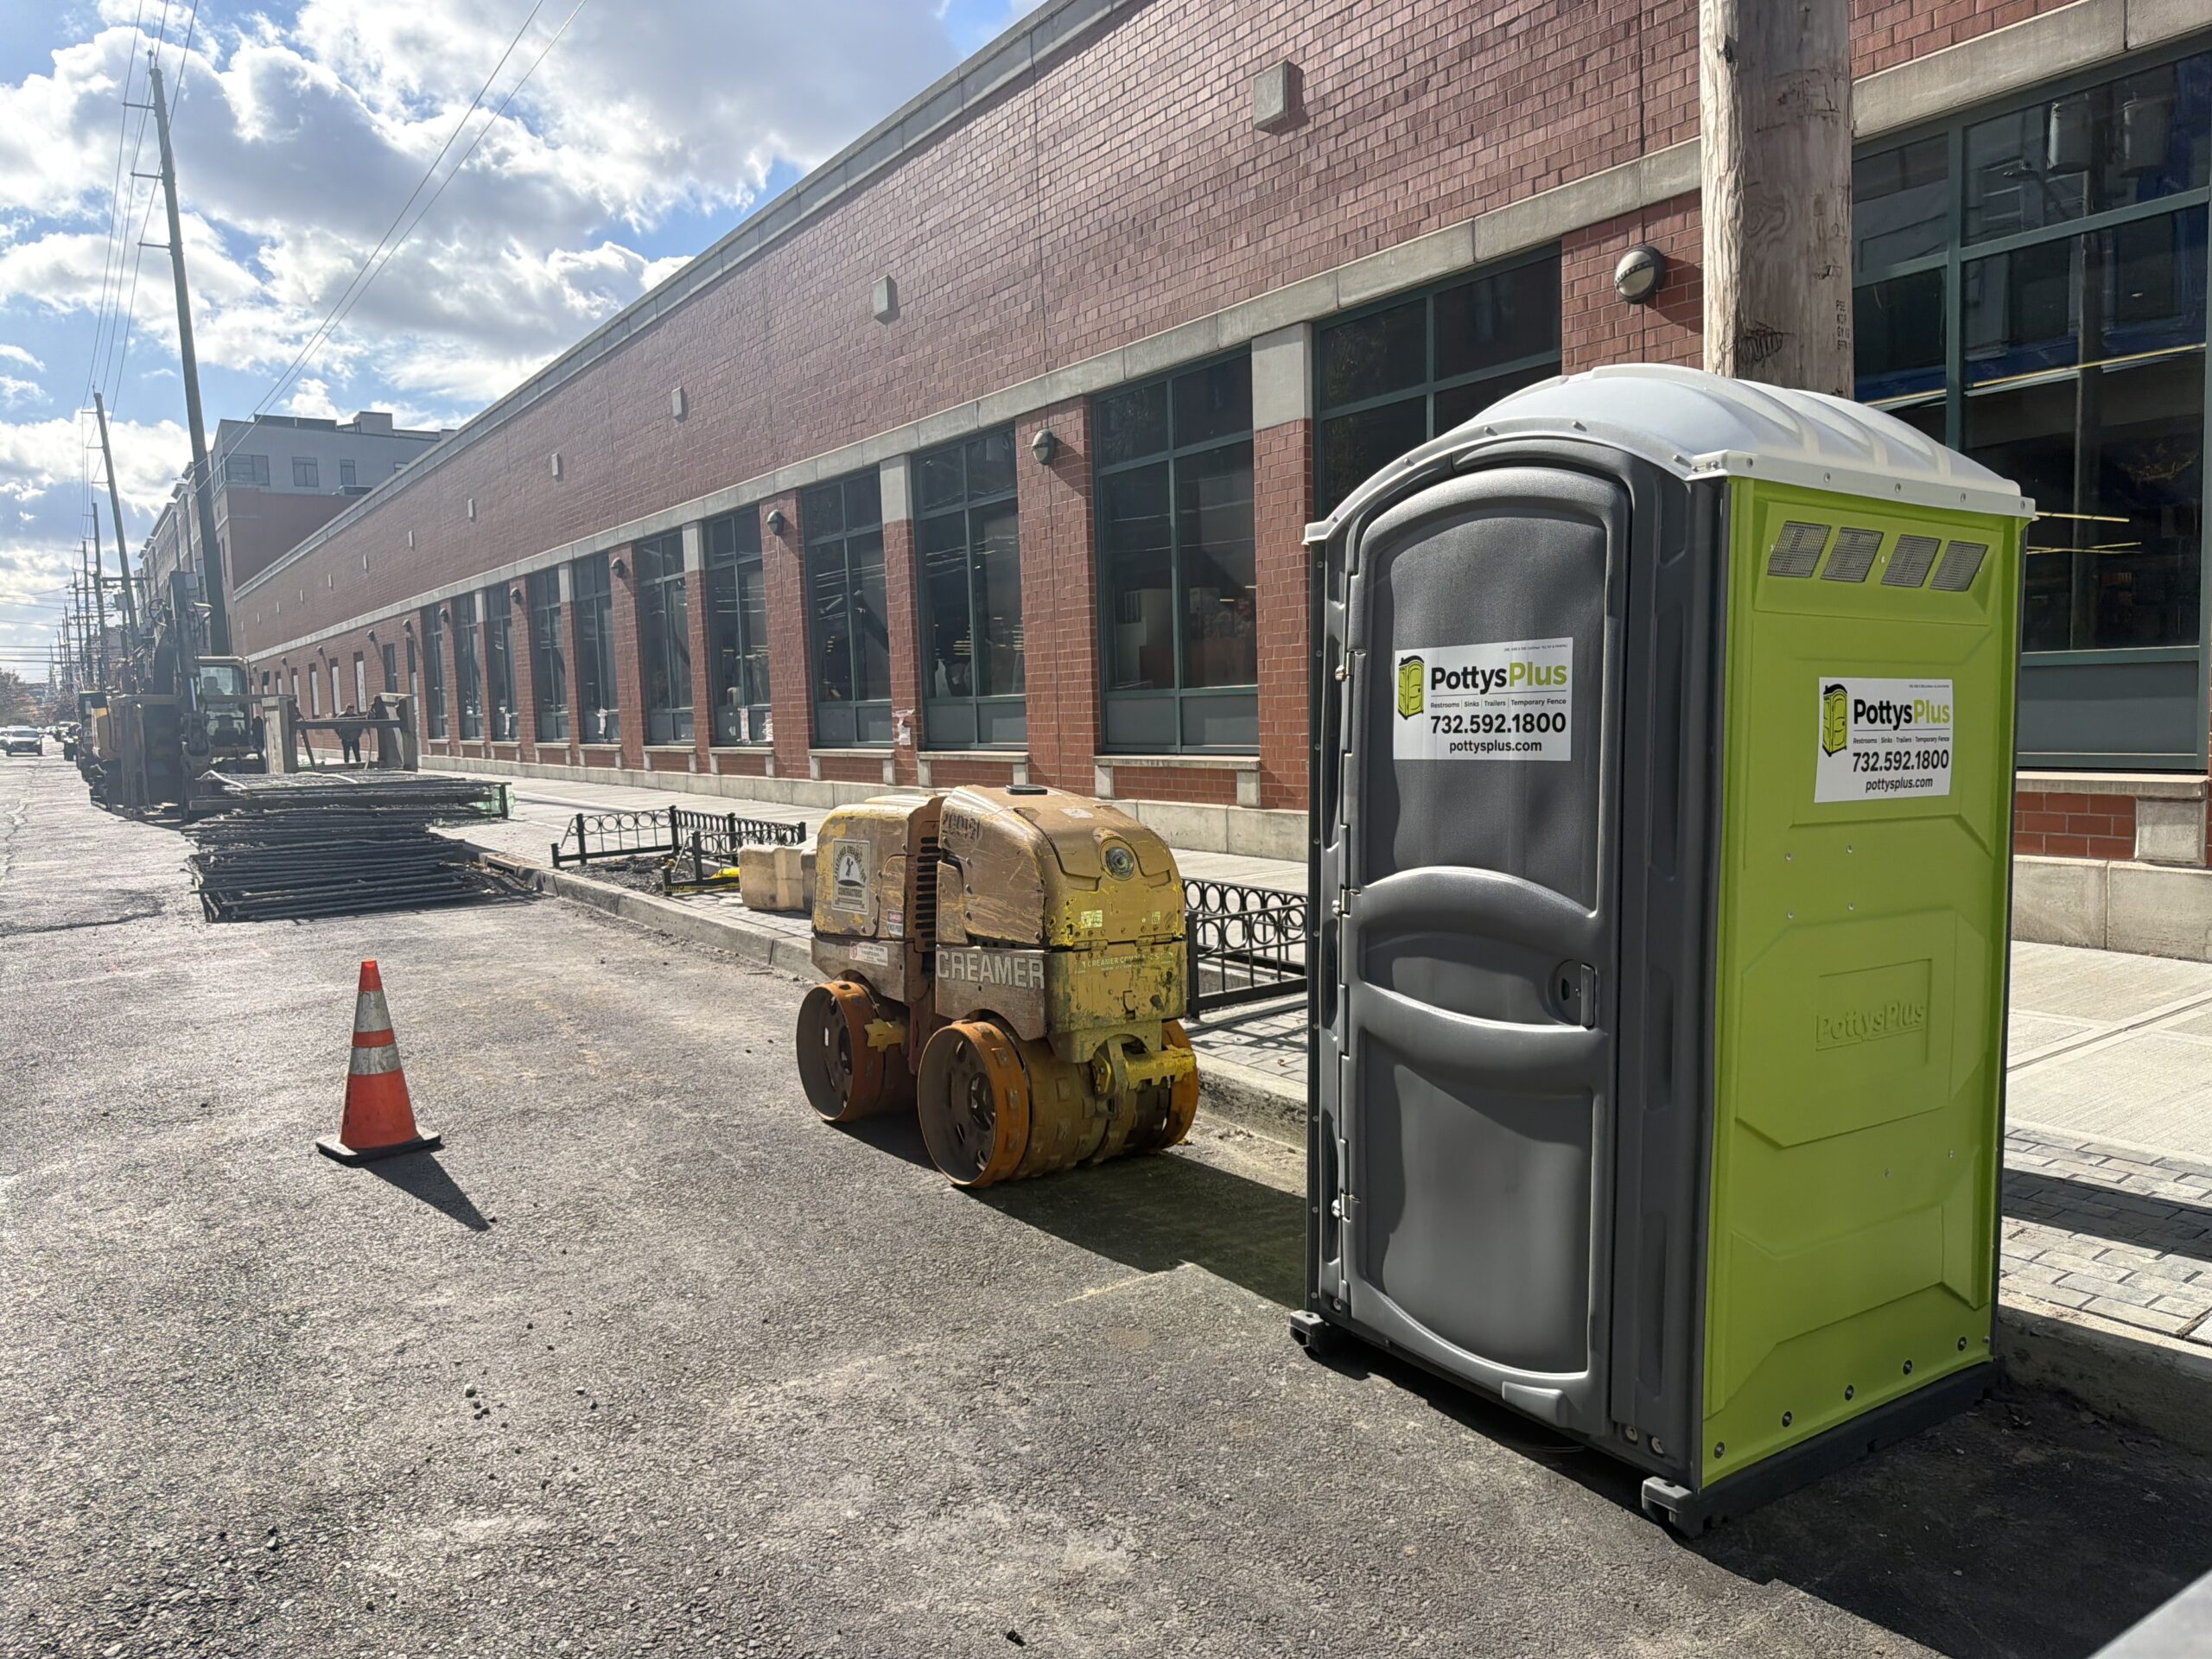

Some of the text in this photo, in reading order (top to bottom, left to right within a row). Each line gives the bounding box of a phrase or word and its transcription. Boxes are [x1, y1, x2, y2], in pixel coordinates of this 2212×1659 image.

[1430, 662, 1567, 695] PottysPlus
[1430, 712, 1567, 734] 732.592.1800
[1853, 699, 1950, 731] PottysPlus
[1449, 739, 1542, 754] pottysplus.com
[1853, 749, 1949, 772] 732.592.1800
[1866, 776, 1933, 793] pottysplus.com
[936, 950, 1045, 989] CREAMER
[1087, 957, 1119, 967] CREAMER
